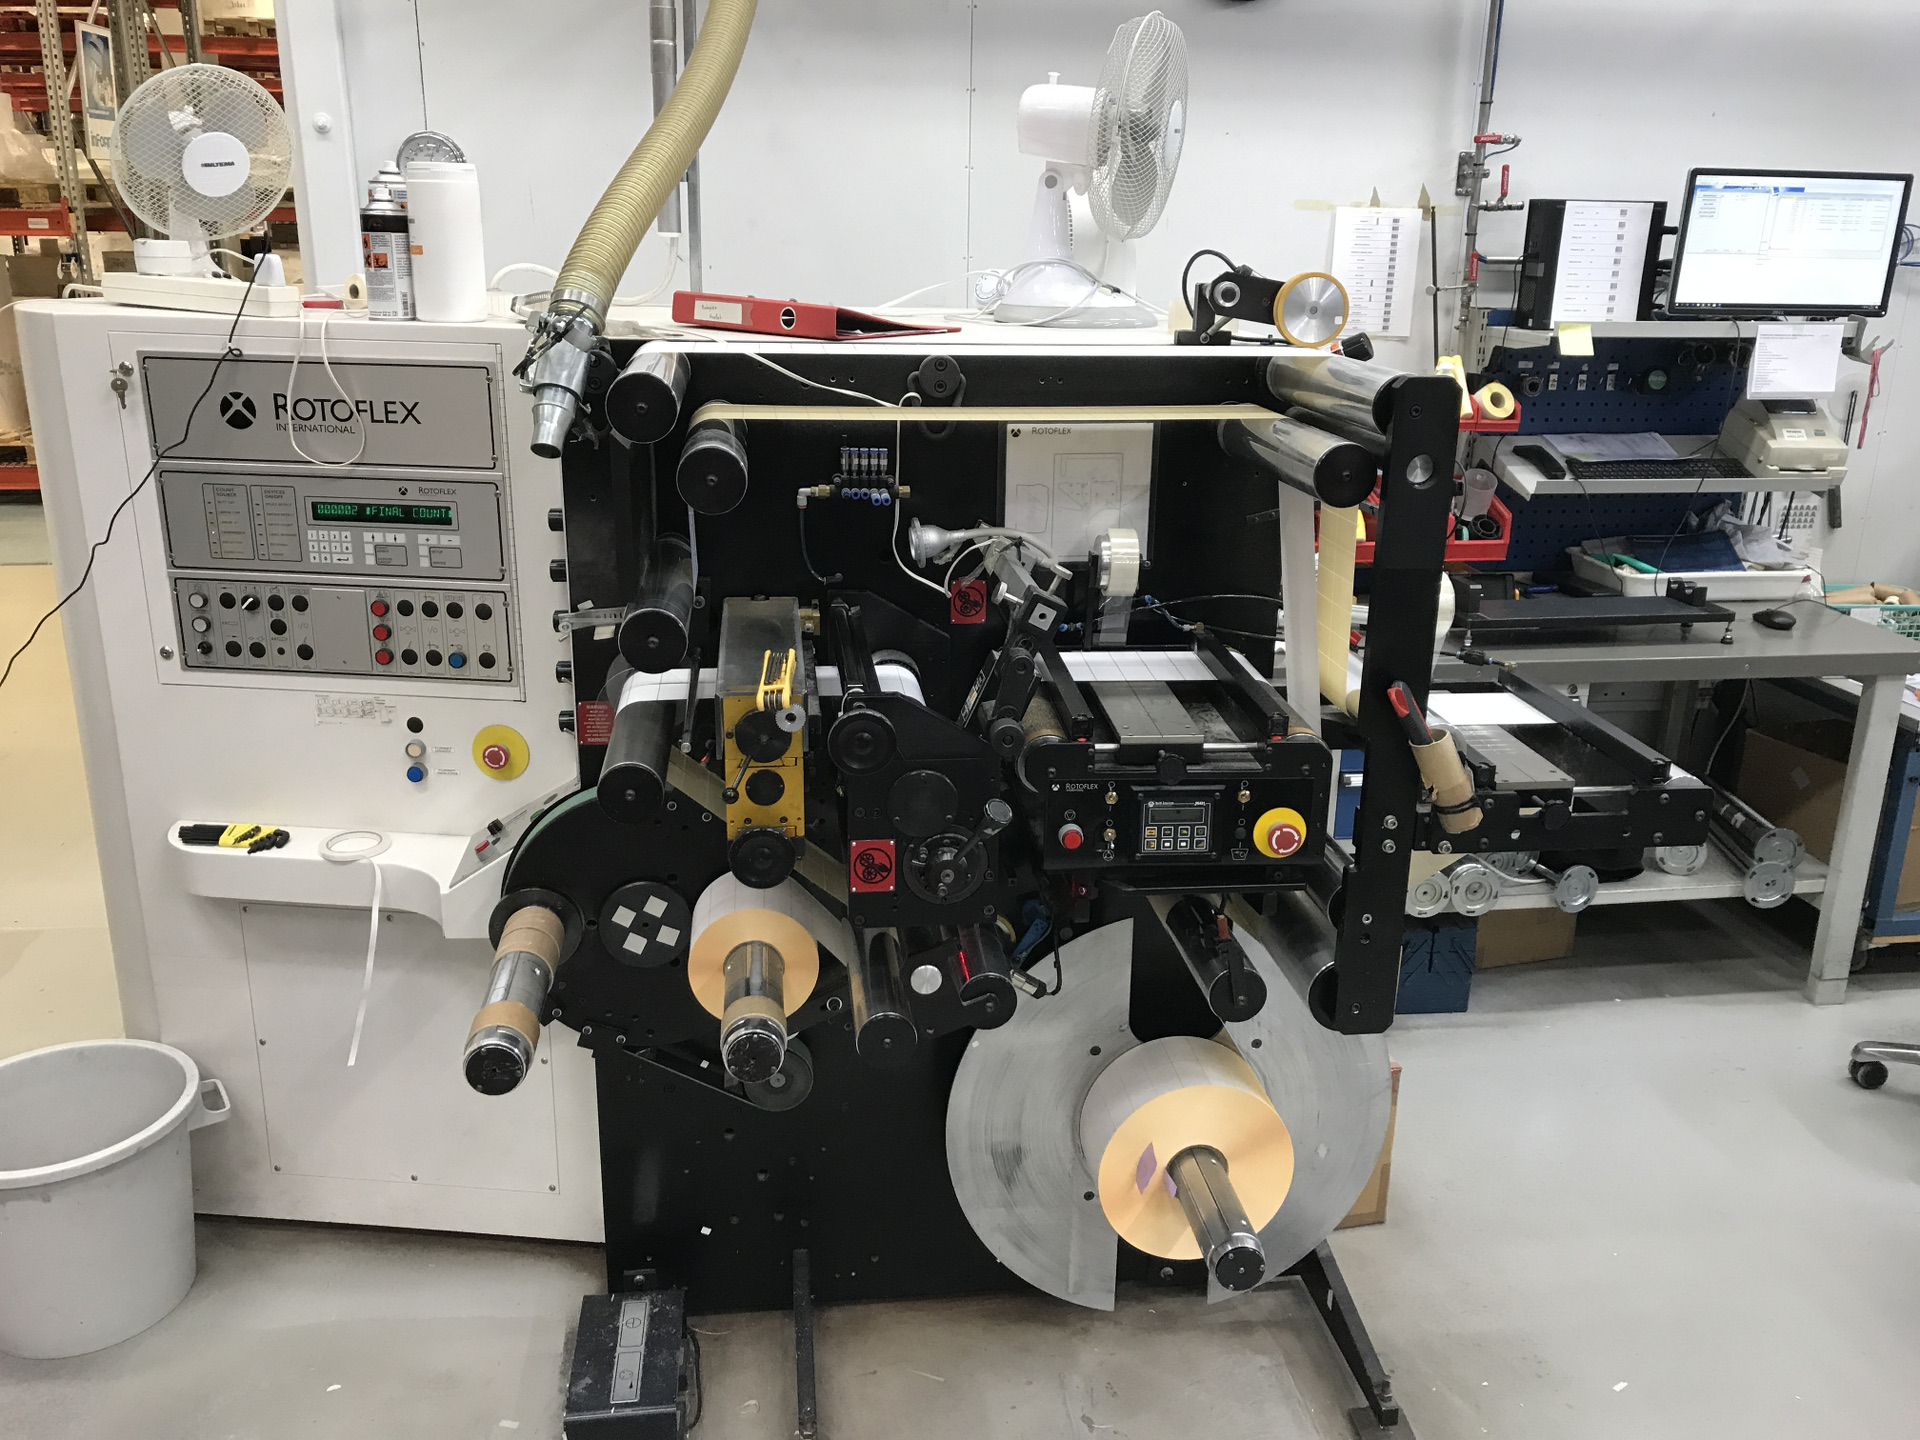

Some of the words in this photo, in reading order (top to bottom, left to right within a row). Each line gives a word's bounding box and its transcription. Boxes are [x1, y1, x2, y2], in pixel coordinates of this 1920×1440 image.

[273, 392, 422, 424] ROTOFLEX
[276, 423, 355, 434] INERNATIONAL
[1031, 426, 1072, 435] ROTOFLEX
[418, 486, 457, 495] ROTOFLEX
[317, 504, 358, 515] 000002
